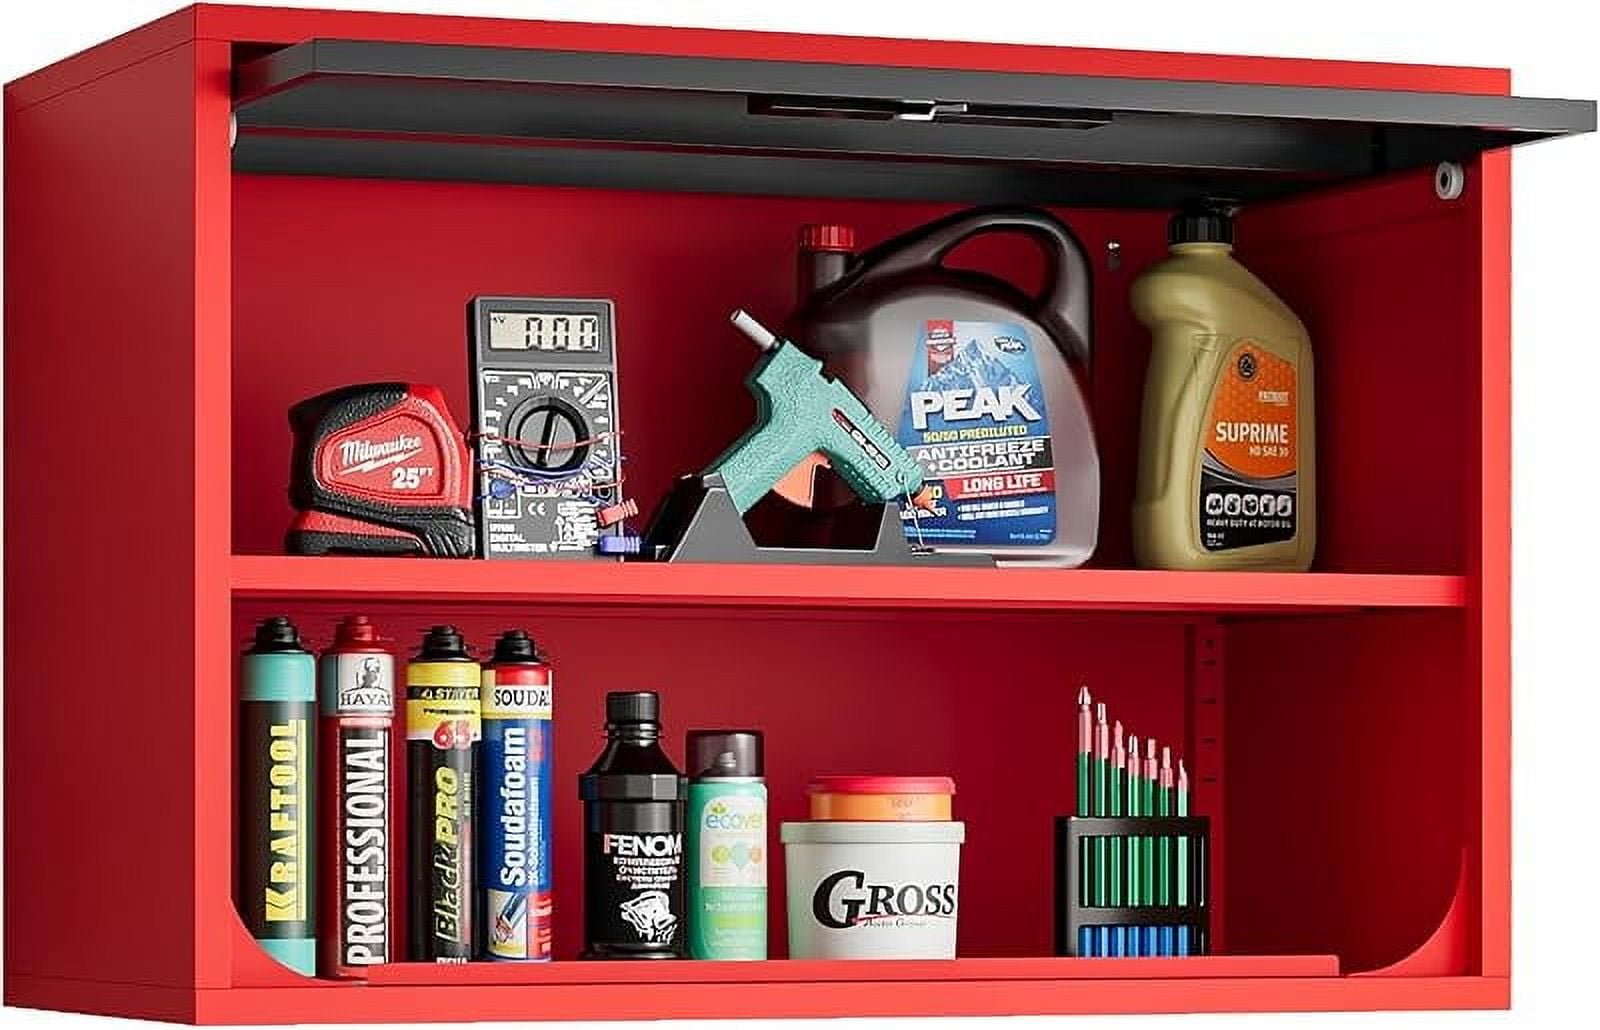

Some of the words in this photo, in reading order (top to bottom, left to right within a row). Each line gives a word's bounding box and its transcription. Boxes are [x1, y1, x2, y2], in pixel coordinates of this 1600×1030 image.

[911, 384, 1042, 430] PEAK
[339, 434, 422, 467] Milwaukee
[917, 439, 1045, 461] ANTIFREEZE
[1215, 421, 1289, 443] SUPRIME
[963, 477, 1004, 492] LONG
[1007, 473, 1042, 488] LIFE
[265, 719, 298, 922] KRAFTOOL
[500, 728, 527, 886] Soudafoam
[345, 731, 386, 965] PROFESSIONAL
[604, 832, 682, 857] FENOM
[812, 870, 955, 929] GROSS
